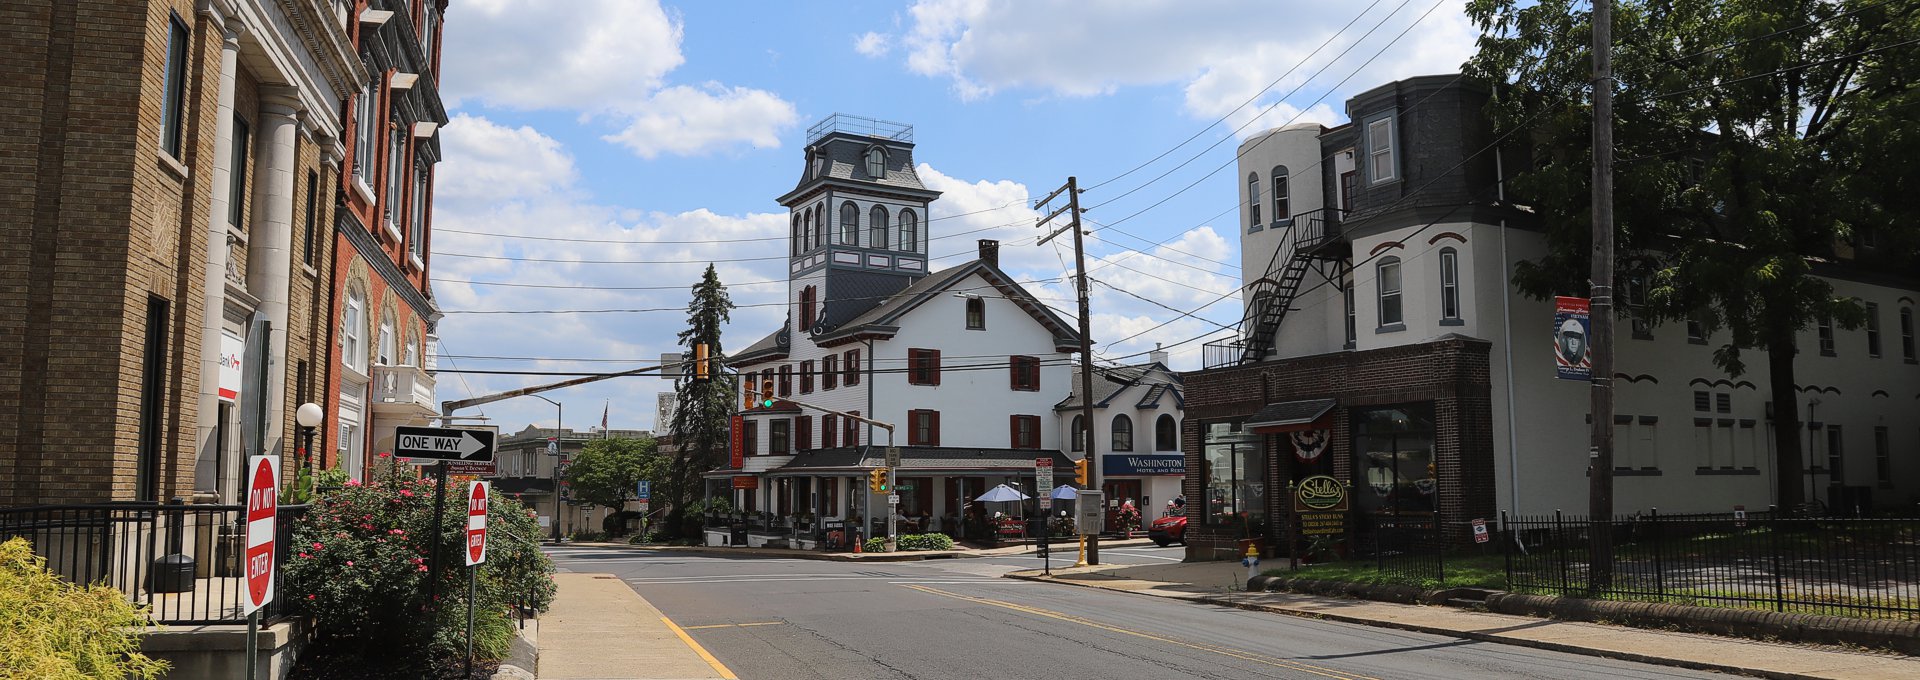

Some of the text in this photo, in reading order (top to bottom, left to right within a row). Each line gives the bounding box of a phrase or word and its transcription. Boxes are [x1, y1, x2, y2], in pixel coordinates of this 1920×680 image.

[402, 436, 461, 450] ONE WAY
[1302, 480, 1340, 498] Stella's
[252, 488, 274, 512] DO NOT
[471, 498, 477, 511] DO
[471, 534, 482, 548] ENTER
[251, 552, 269, 580] ENTER
